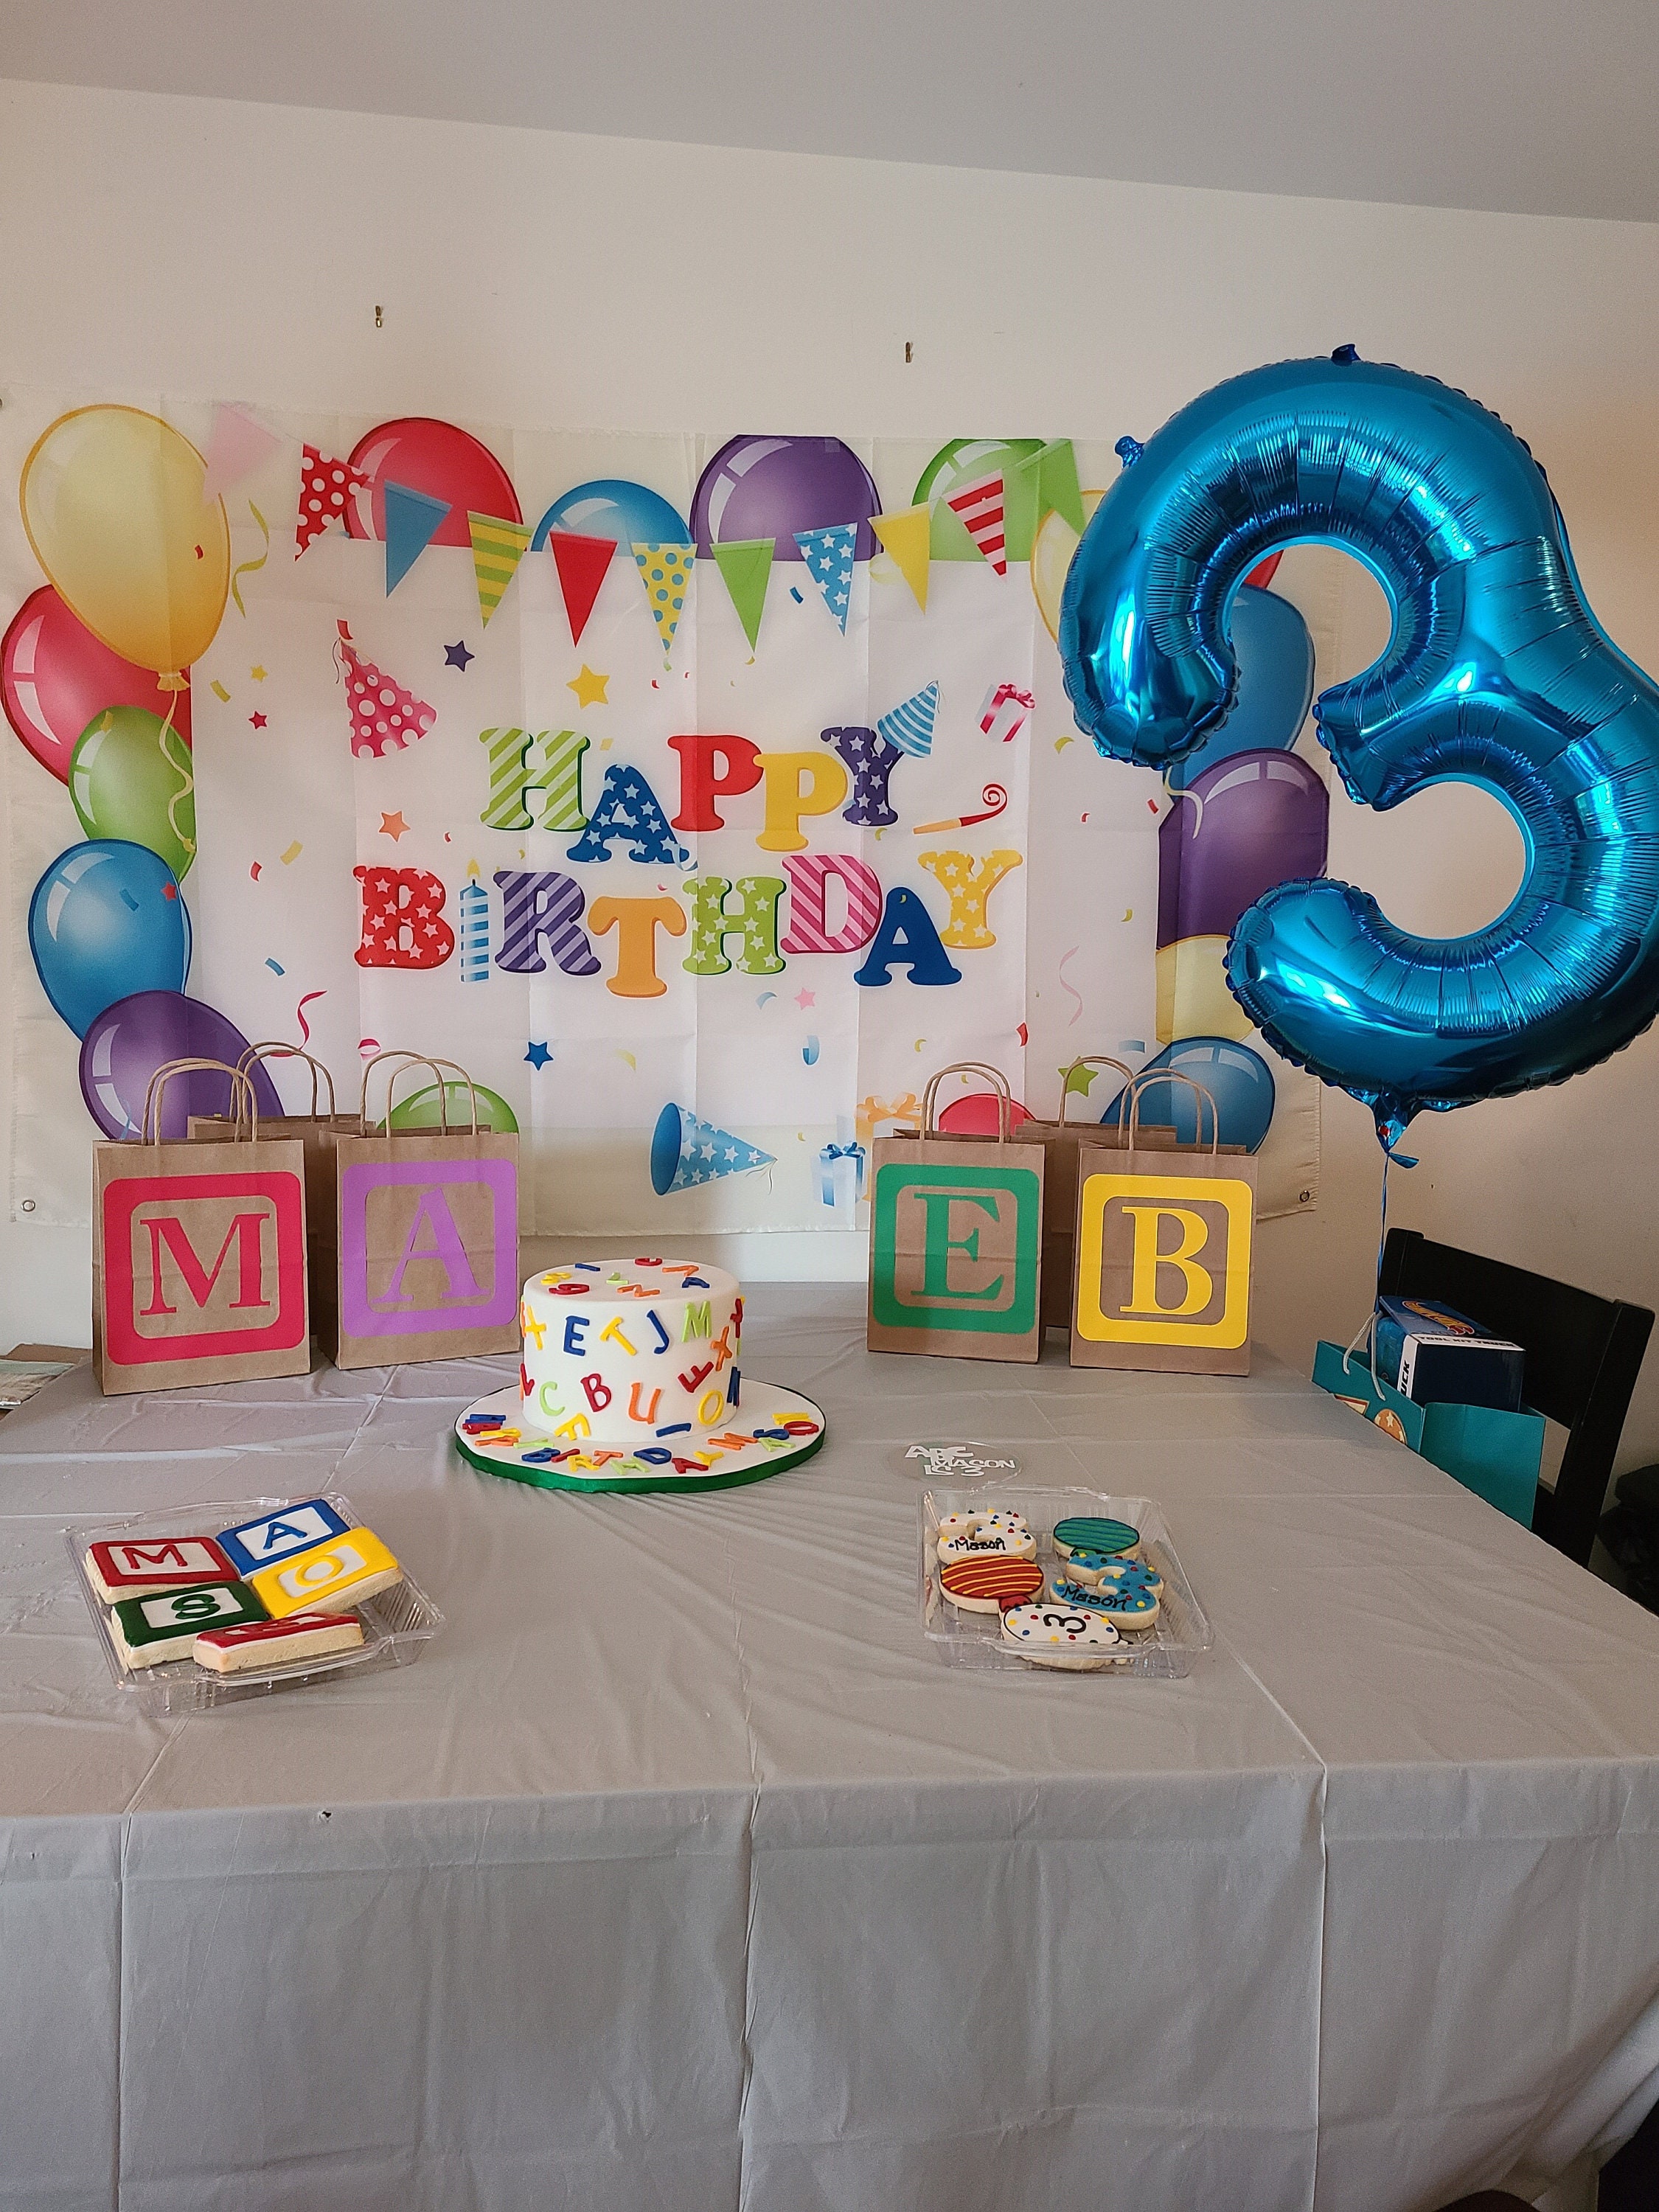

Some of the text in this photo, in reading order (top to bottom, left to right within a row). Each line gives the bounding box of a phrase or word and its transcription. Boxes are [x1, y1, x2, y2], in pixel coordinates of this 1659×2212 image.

[478, 726, 908, 865] HAPPY
[352, 849, 1023, 998] BIRTHDAY
[139, 1213, 271, 1317] M
[372, 1188, 490, 1304] A
[911, 1192, 1004, 1301] E
[1119, 1205, 1214, 1316] B
[121, 1543, 188, 1570] M
[263, 1521, 307, 1550] A
[171, 1593, 221, 1621] S
[1062, 1585, 1130, 1611] Mason
